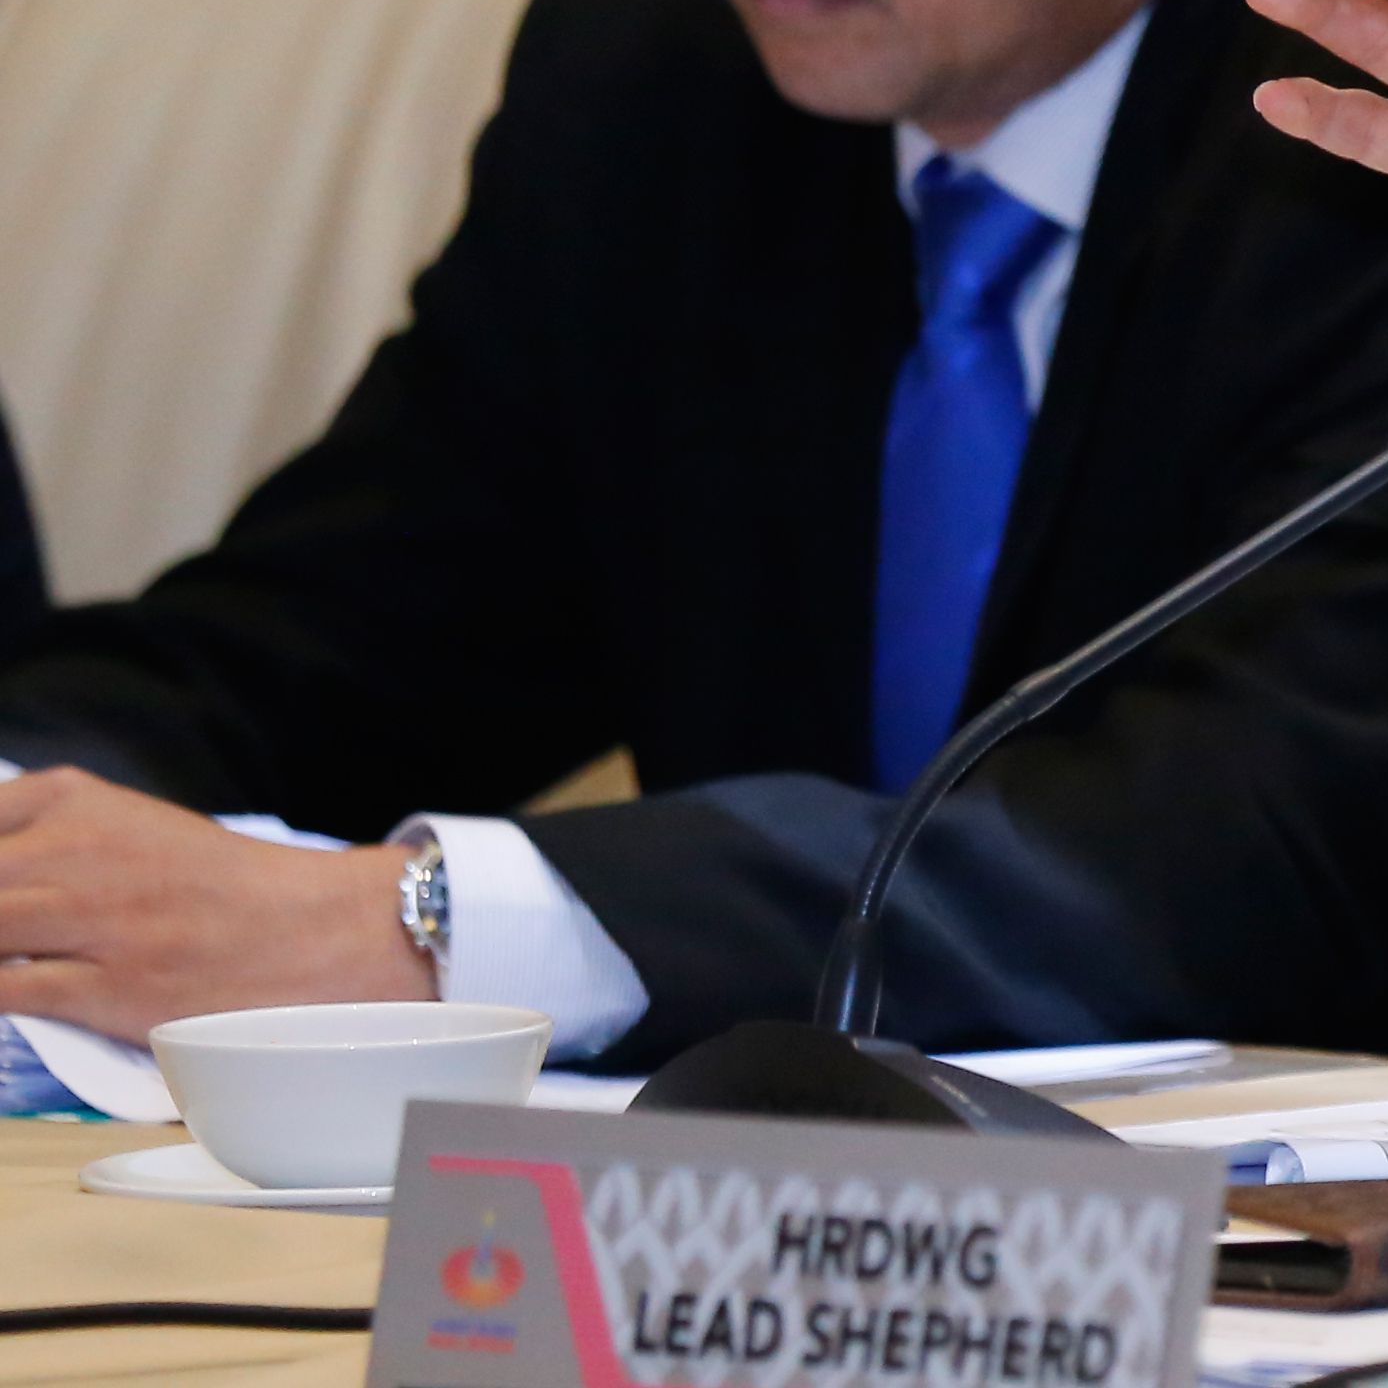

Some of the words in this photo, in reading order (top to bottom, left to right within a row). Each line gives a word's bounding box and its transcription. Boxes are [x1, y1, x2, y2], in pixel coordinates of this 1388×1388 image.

[771, 1212, 1000, 1289] HRDWG
[632, 1292, 784, 1362] LEAD
[801, 1302, 1120, 1385] SHEPHERD
